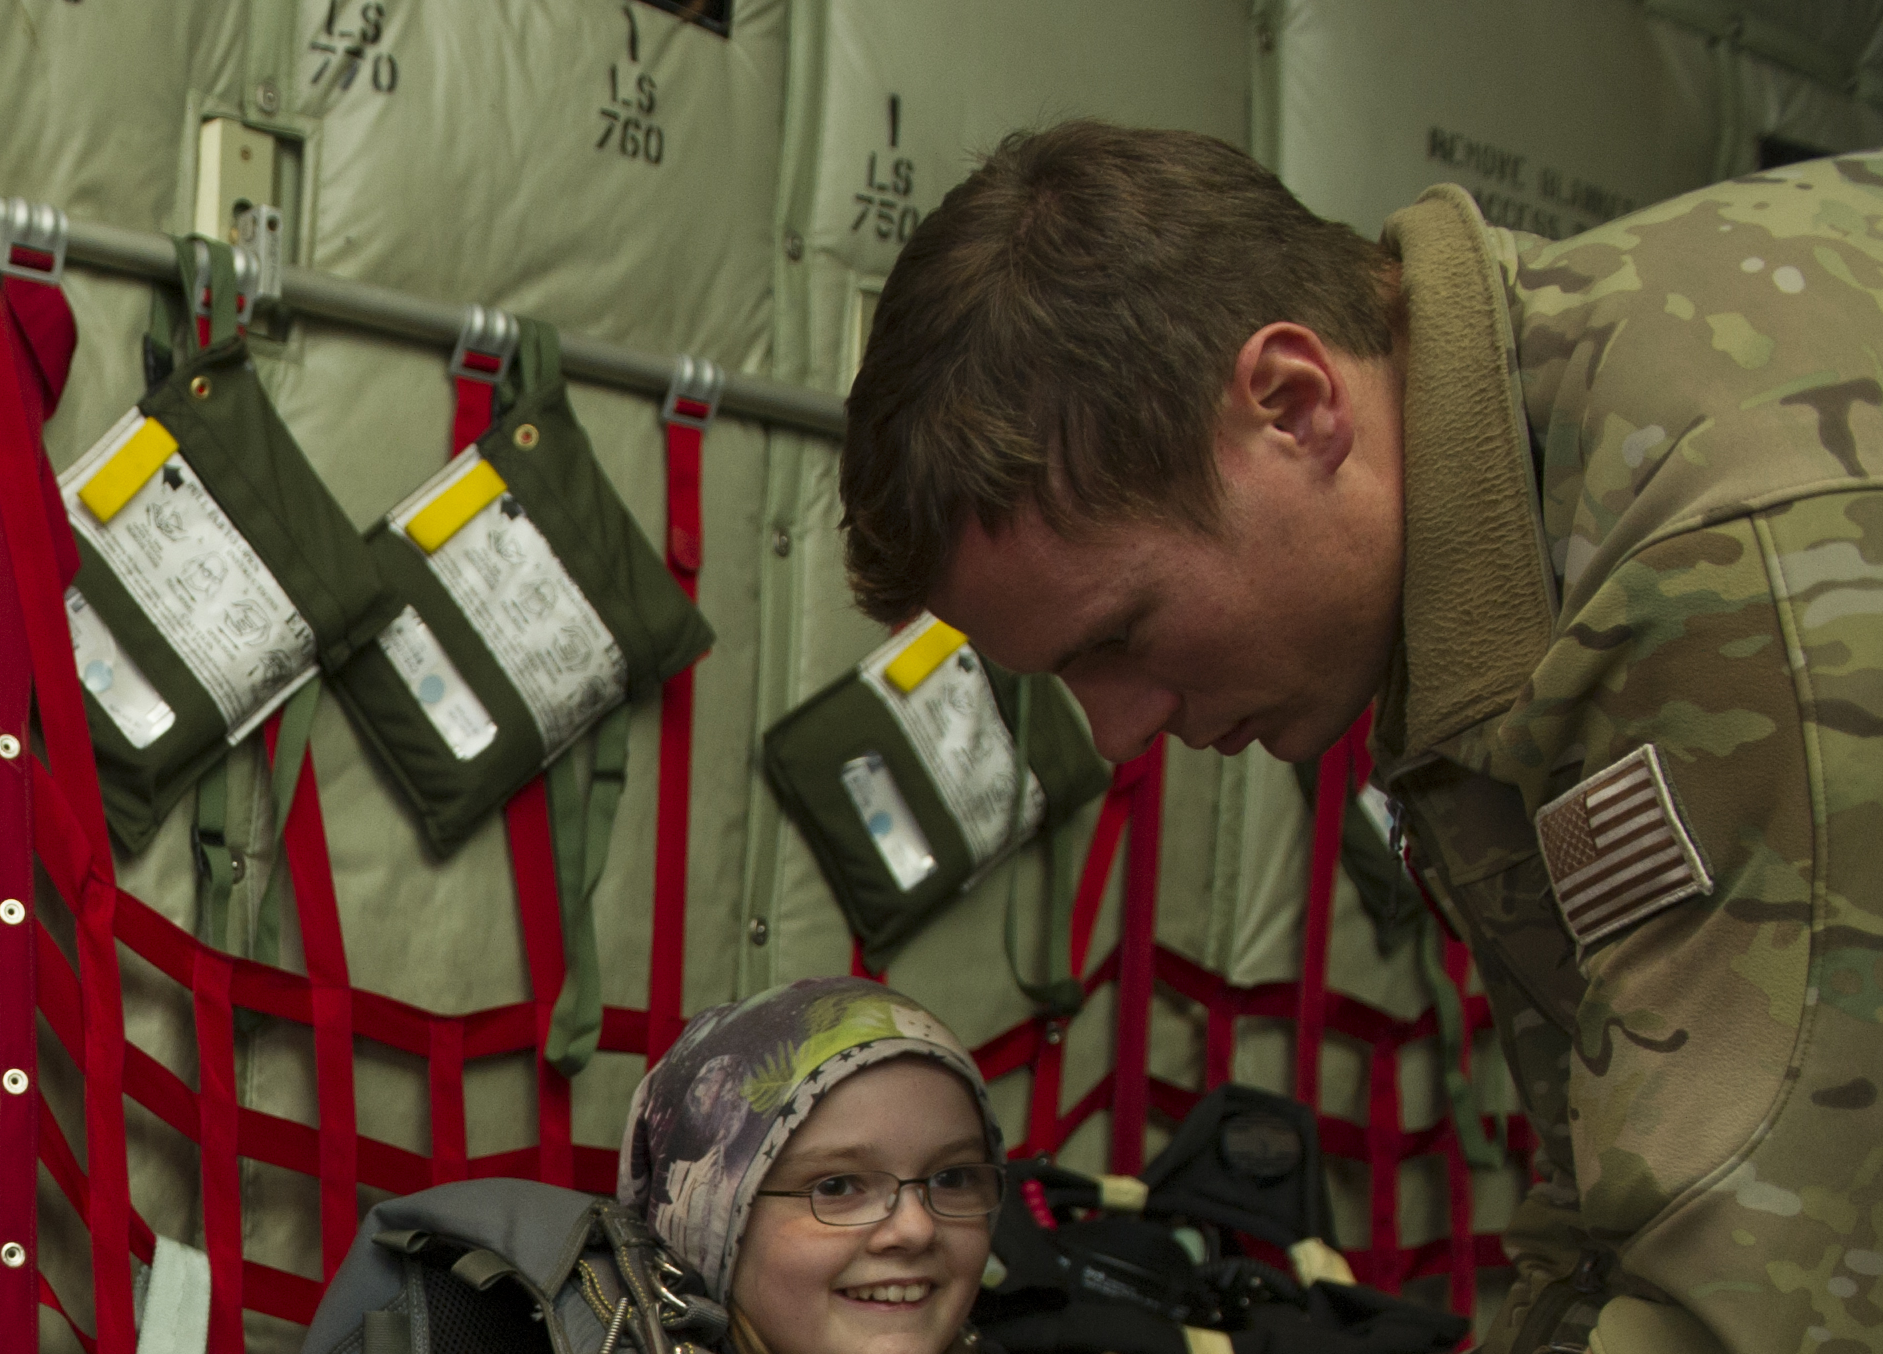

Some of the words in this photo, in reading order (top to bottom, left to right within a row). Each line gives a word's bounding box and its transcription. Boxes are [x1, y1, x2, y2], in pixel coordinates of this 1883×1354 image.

[310, 41, 399, 93] 770
[608, 63, 657, 115] LS
[594, 107, 665, 166] 760
[865, 152, 913, 196] LS
[850, 194, 917, 245] 750
